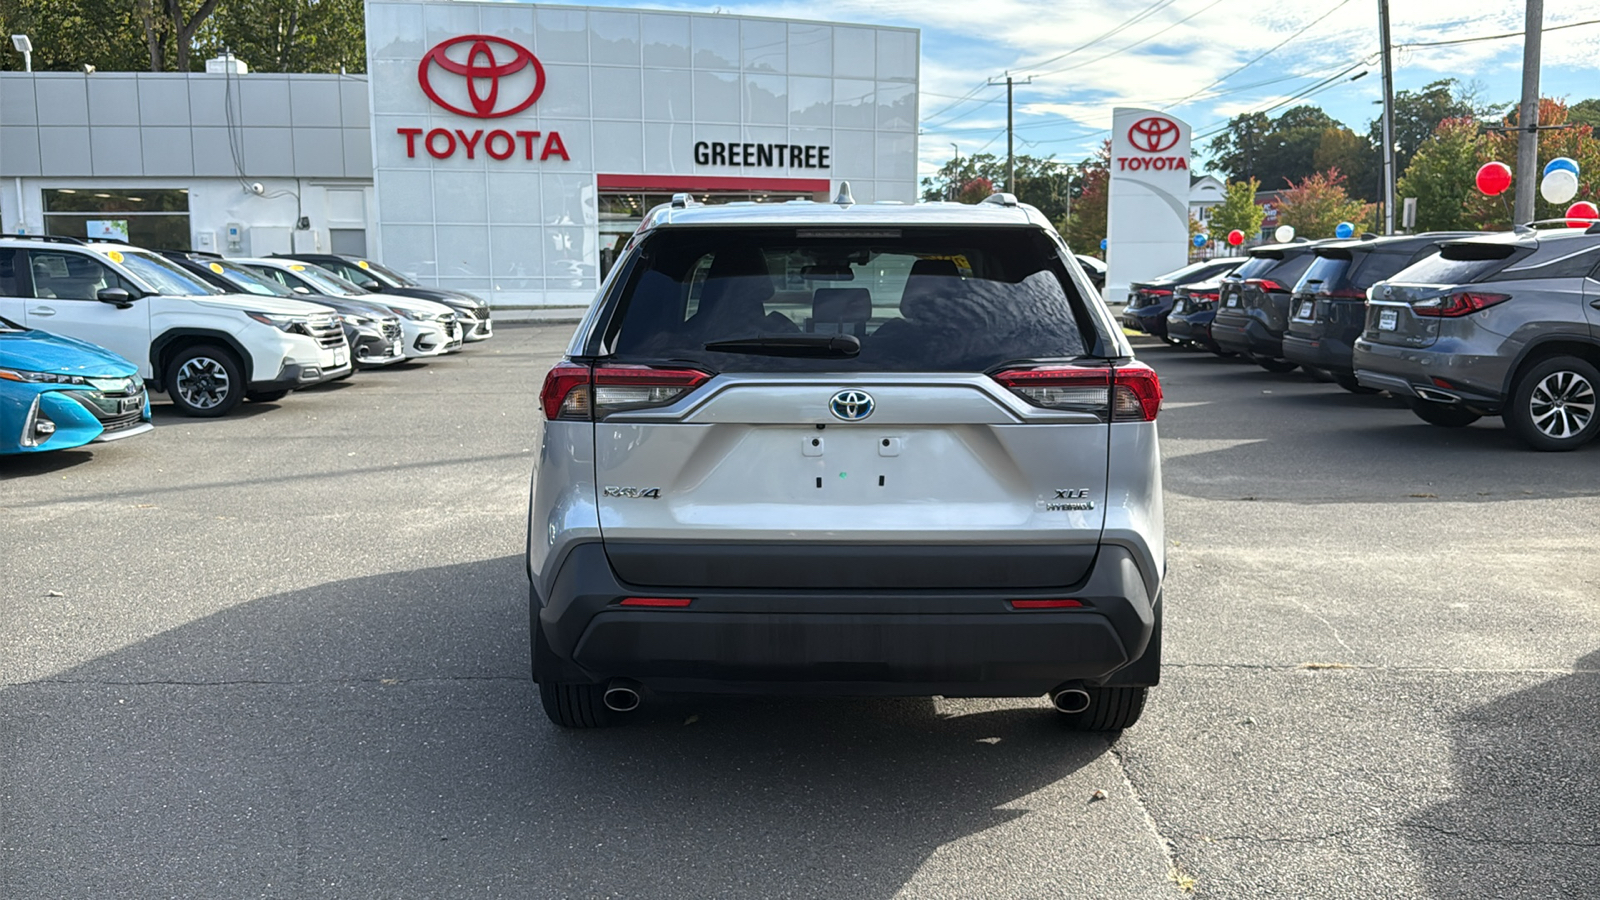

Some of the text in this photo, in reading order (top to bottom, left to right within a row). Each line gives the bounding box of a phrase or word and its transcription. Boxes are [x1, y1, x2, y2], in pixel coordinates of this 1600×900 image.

[397, 127, 571, 161] TOYOTA
[694, 141, 830, 169] GREENTREE
[1117, 156, 1188, 171] TOYOTA
[602, 485, 662, 500] RAV4
[1053, 488, 1090, 500] XLE
[1046, 502, 1088, 511] HYBRID
